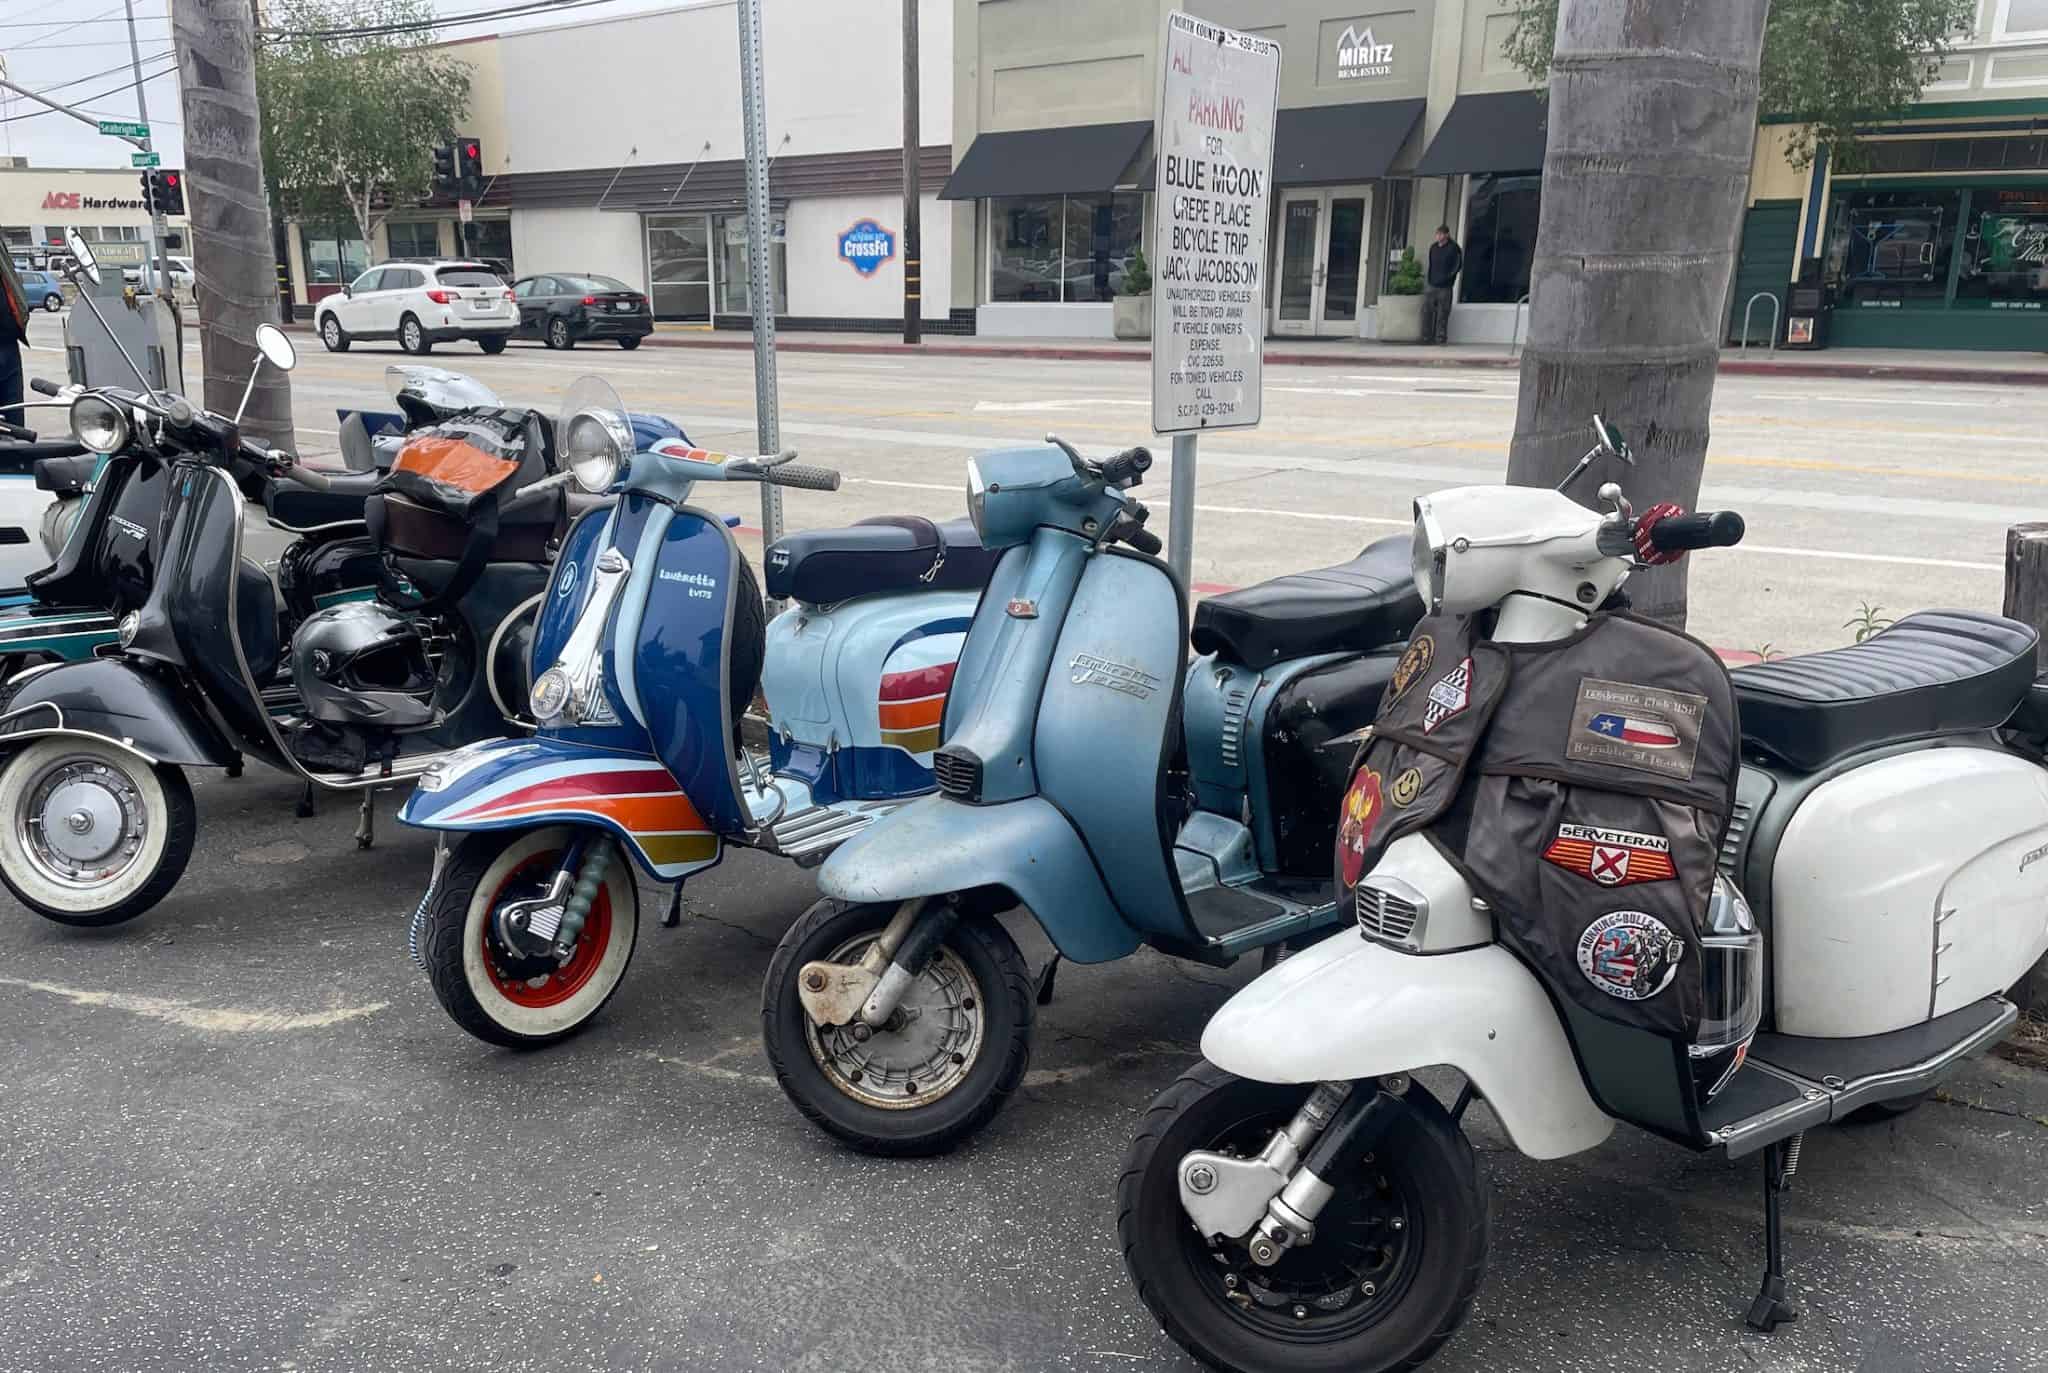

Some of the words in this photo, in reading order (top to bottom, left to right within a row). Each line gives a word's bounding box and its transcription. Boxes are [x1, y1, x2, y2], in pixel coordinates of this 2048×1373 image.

[1174, 14, 1196, 33] NORTH
[1196, 23, 1225, 42] COUNT
[1339, 44, 1393, 66] MIRITZ
[1189, 96, 1245, 133] PARKING
[1206, 135, 1223, 155] FOR
[1166, 154, 1205, 190] BLUE
[1212, 163, 1263, 198] MOON
[41, 192, 80, 209] ACE
[83, 196, 144, 209] Hardwar
[1173, 195, 1210, 223] CREPE
[1214, 201, 1251, 227] PLACE
[844, 241, 889, 257] CrossFit
[1173, 226, 1219, 254] BICYCLE
[1224, 231, 1249, 256] TRIP
[1163, 255, 1190, 281] JACK
[1195, 258, 1258, 285] JACOBSON
[1167, 288, 1216, 302] UNAUTHORIZED
[1219, 290, 1251, 303] VEHICLES
[1172, 304, 1187, 318] WILL
[1189, 305, 1198, 318] BE
[1200, 306, 1223, 319] TOWED
[1226, 307, 1243, 319] AWAY
[1173, 321, 1181, 335] AT
[1183, 322, 1209, 335] VEHICLE
[1187, 354, 1200, 367] CVC
[1170, 371, 1184, 385] FOR
[1185, 371, 1207, 384] TOWED
[1209, 370, 1243, 383] VEHICLES
[1196, 388, 1212, 400] CALL
[1561, 826, 1668, 850] SERVETERAN
[1581, 915, 1618, 951] RUNNING
